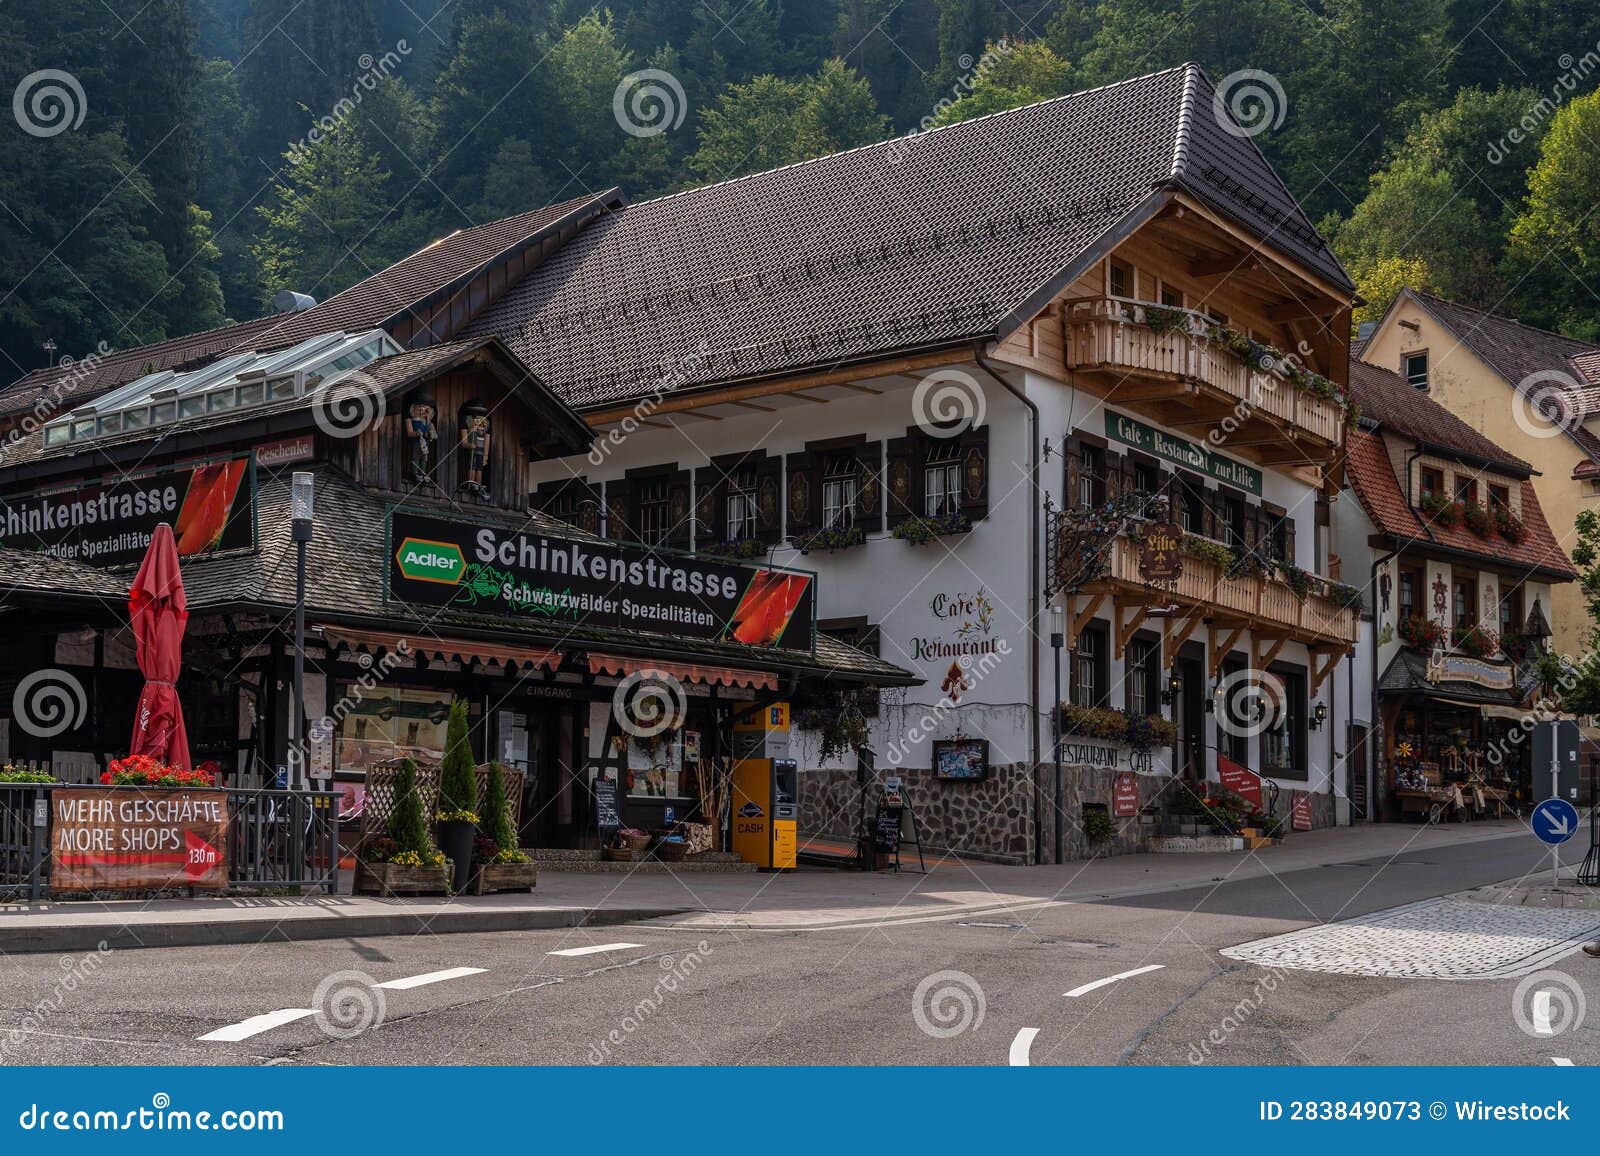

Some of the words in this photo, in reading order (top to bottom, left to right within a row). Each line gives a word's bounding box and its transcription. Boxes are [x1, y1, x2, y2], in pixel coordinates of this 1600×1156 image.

[82, 531, 153, 559] Spezialitäte
[404, 551, 458, 570] Adler
[475, 529, 737, 600] Schinkenstrasse
[502, 582, 618, 615] Schwarzwälder
[621, 598, 714, 627] Spezialitäten
[527, 686, 572, 699] EINGANG
[1060, 744, 1120, 768] ESTAURANT
[59, 799, 116, 823] MEHR
[119, 795, 222, 823] GESCHÄFTE
[59, 828, 114, 851] MORE
[120, 828, 180, 851] SHOPS
[738, 823, 764, 833] CASH
